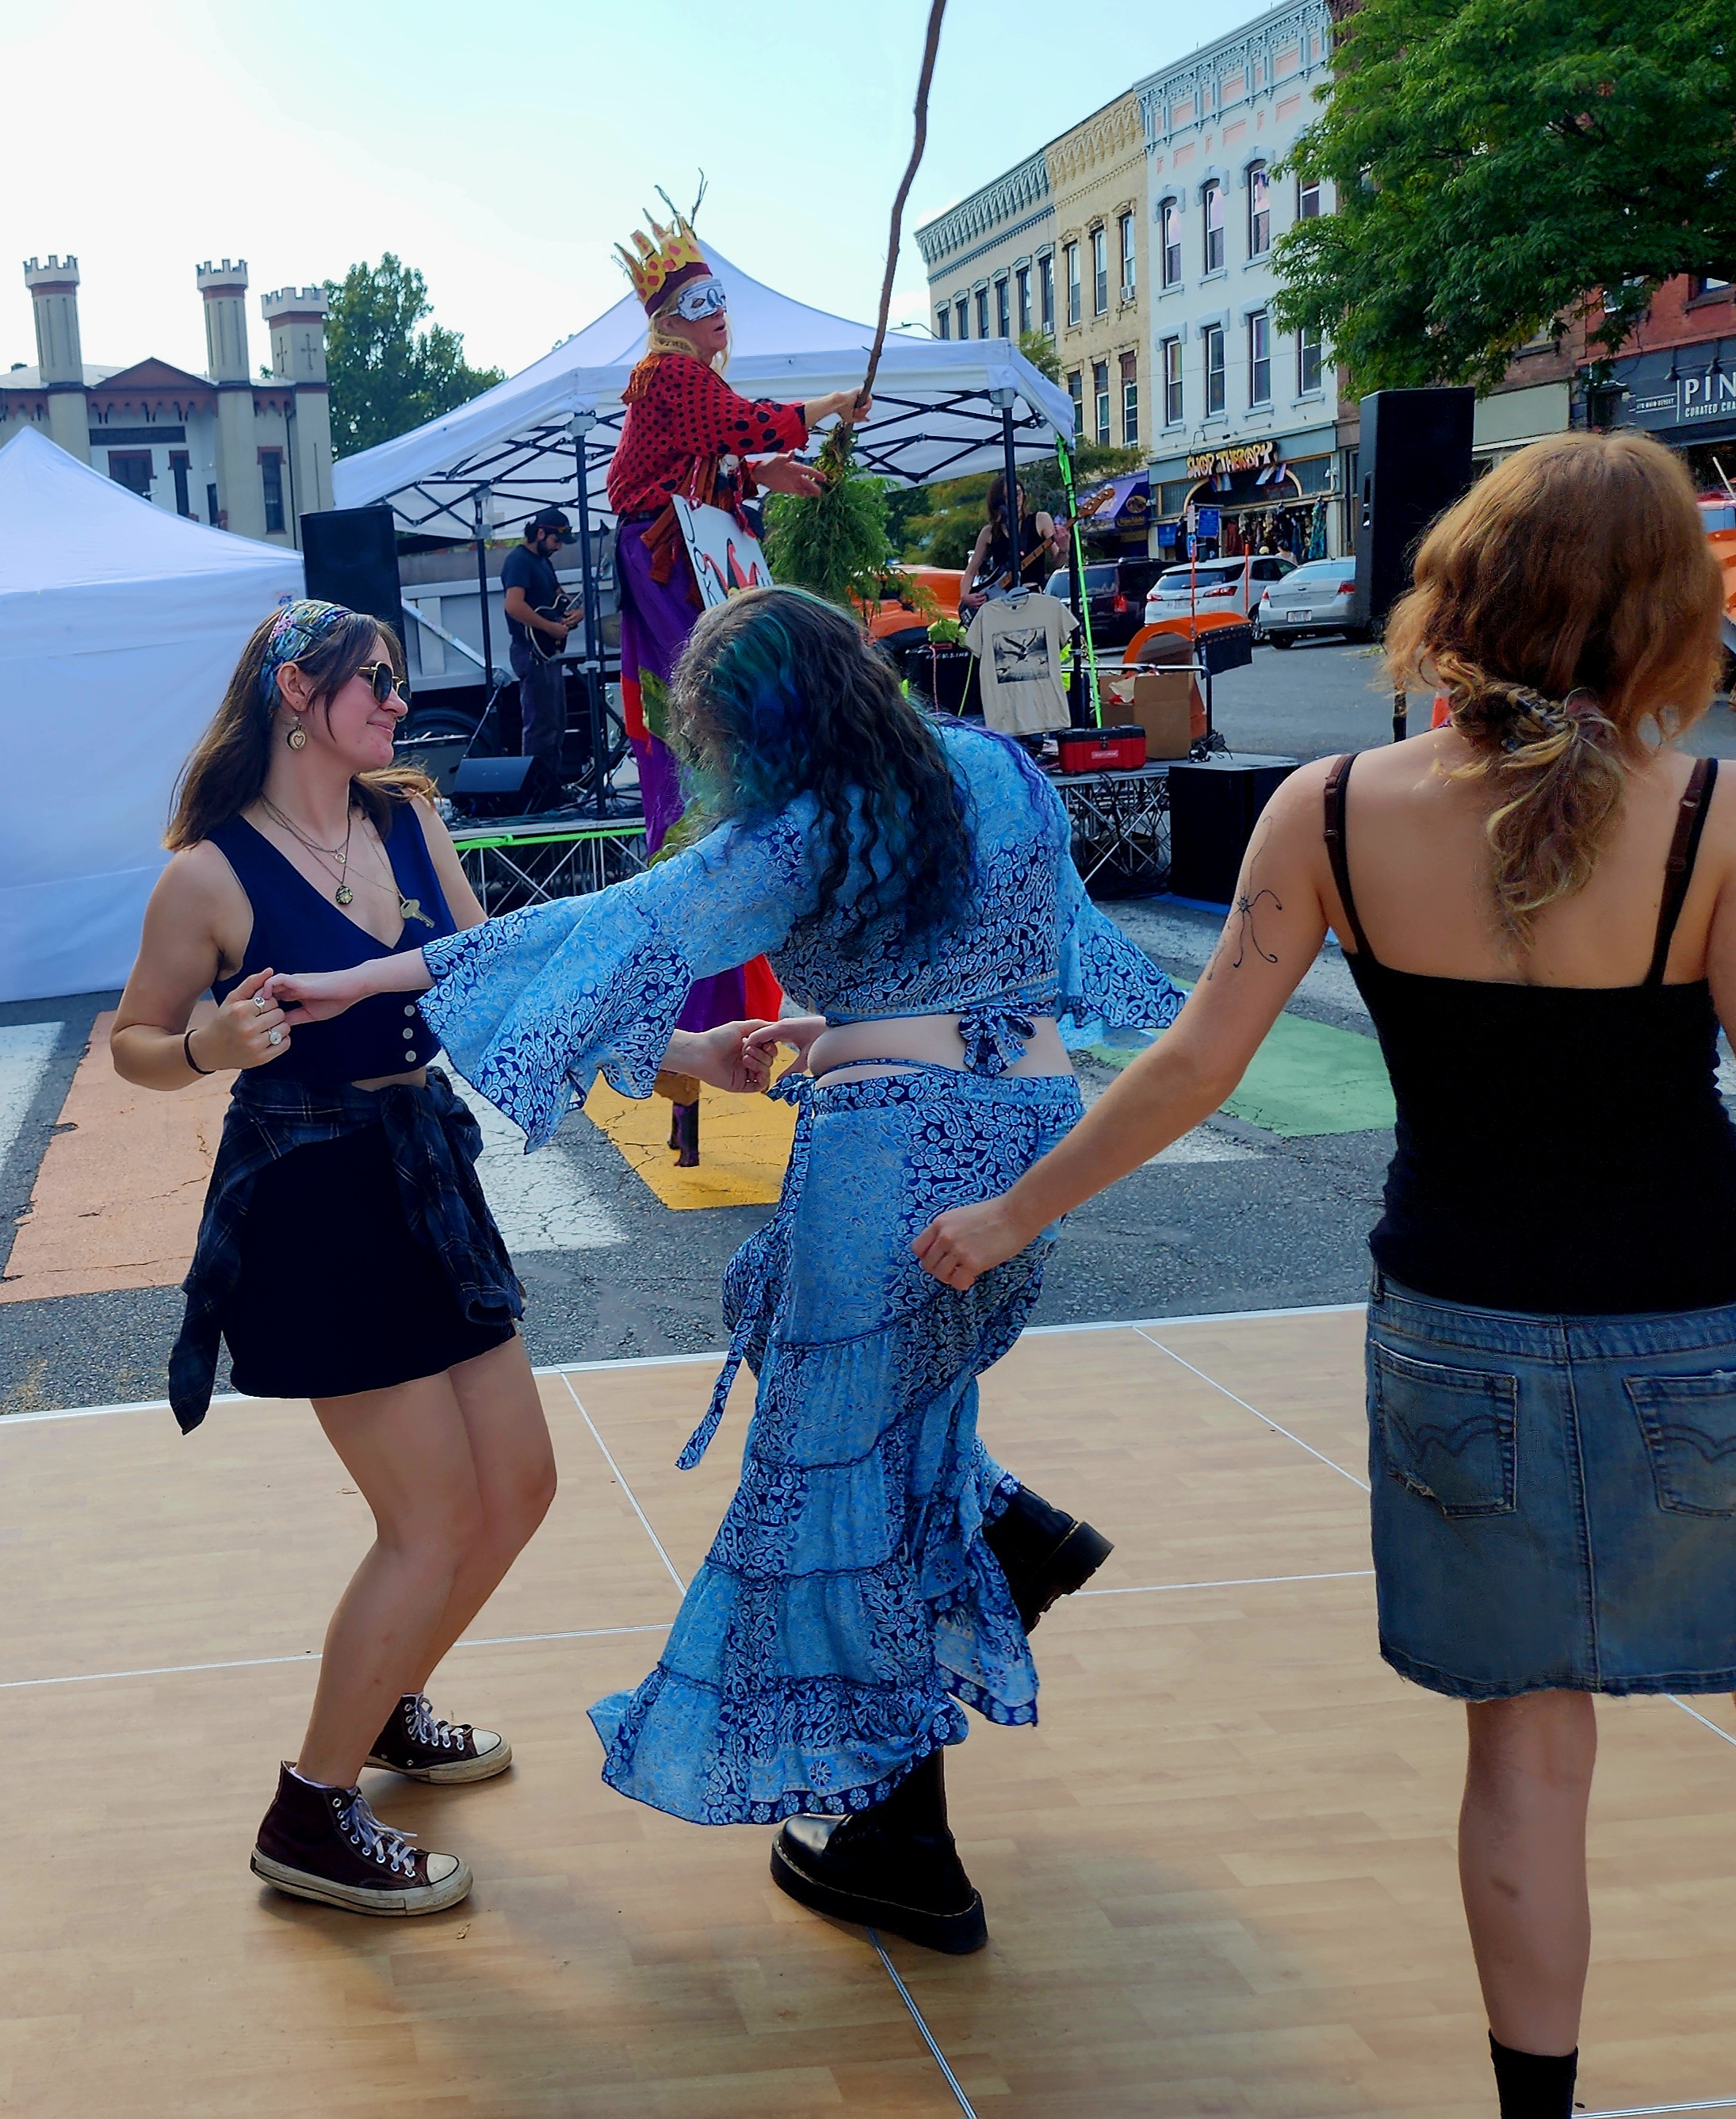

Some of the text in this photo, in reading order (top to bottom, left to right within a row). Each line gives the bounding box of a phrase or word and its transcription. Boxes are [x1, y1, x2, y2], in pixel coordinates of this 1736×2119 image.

[1684, 372, 1736, 404] PIN
[1684, 404, 1718, 417] CURATED
[1186, 441, 1273, 479] SHOP THERAPY
